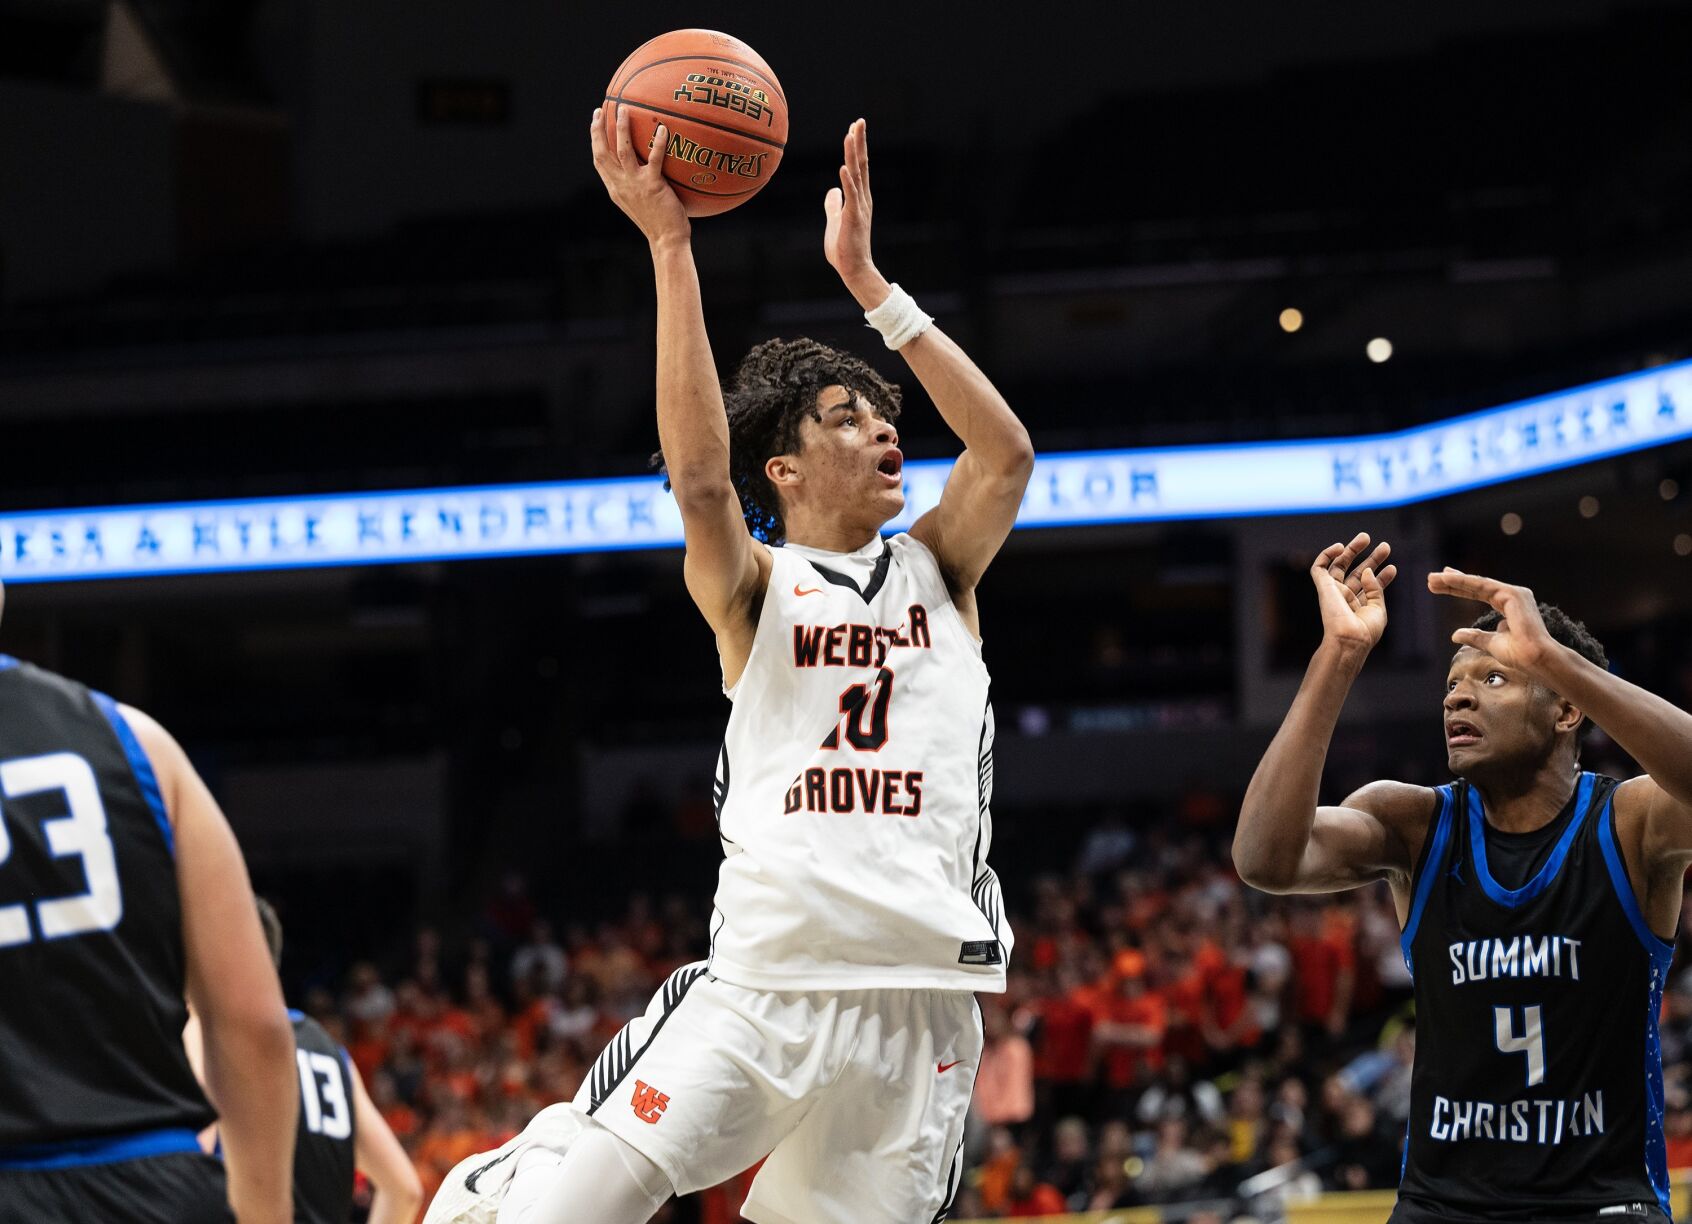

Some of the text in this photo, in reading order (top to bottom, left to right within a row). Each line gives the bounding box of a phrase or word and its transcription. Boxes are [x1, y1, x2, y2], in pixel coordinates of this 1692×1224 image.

[673, 84, 774, 128] LEGACY
[687, 73, 751, 95] 1000
[819, 667, 894, 752] 10
[784, 767, 923, 817] GROVES
[1449, 935, 1582, 985] SUMMIT
[1493, 1003, 1545, 1088] 4
[296, 1048, 352, 1140] 13
[631, 1079, 670, 1124] WG
